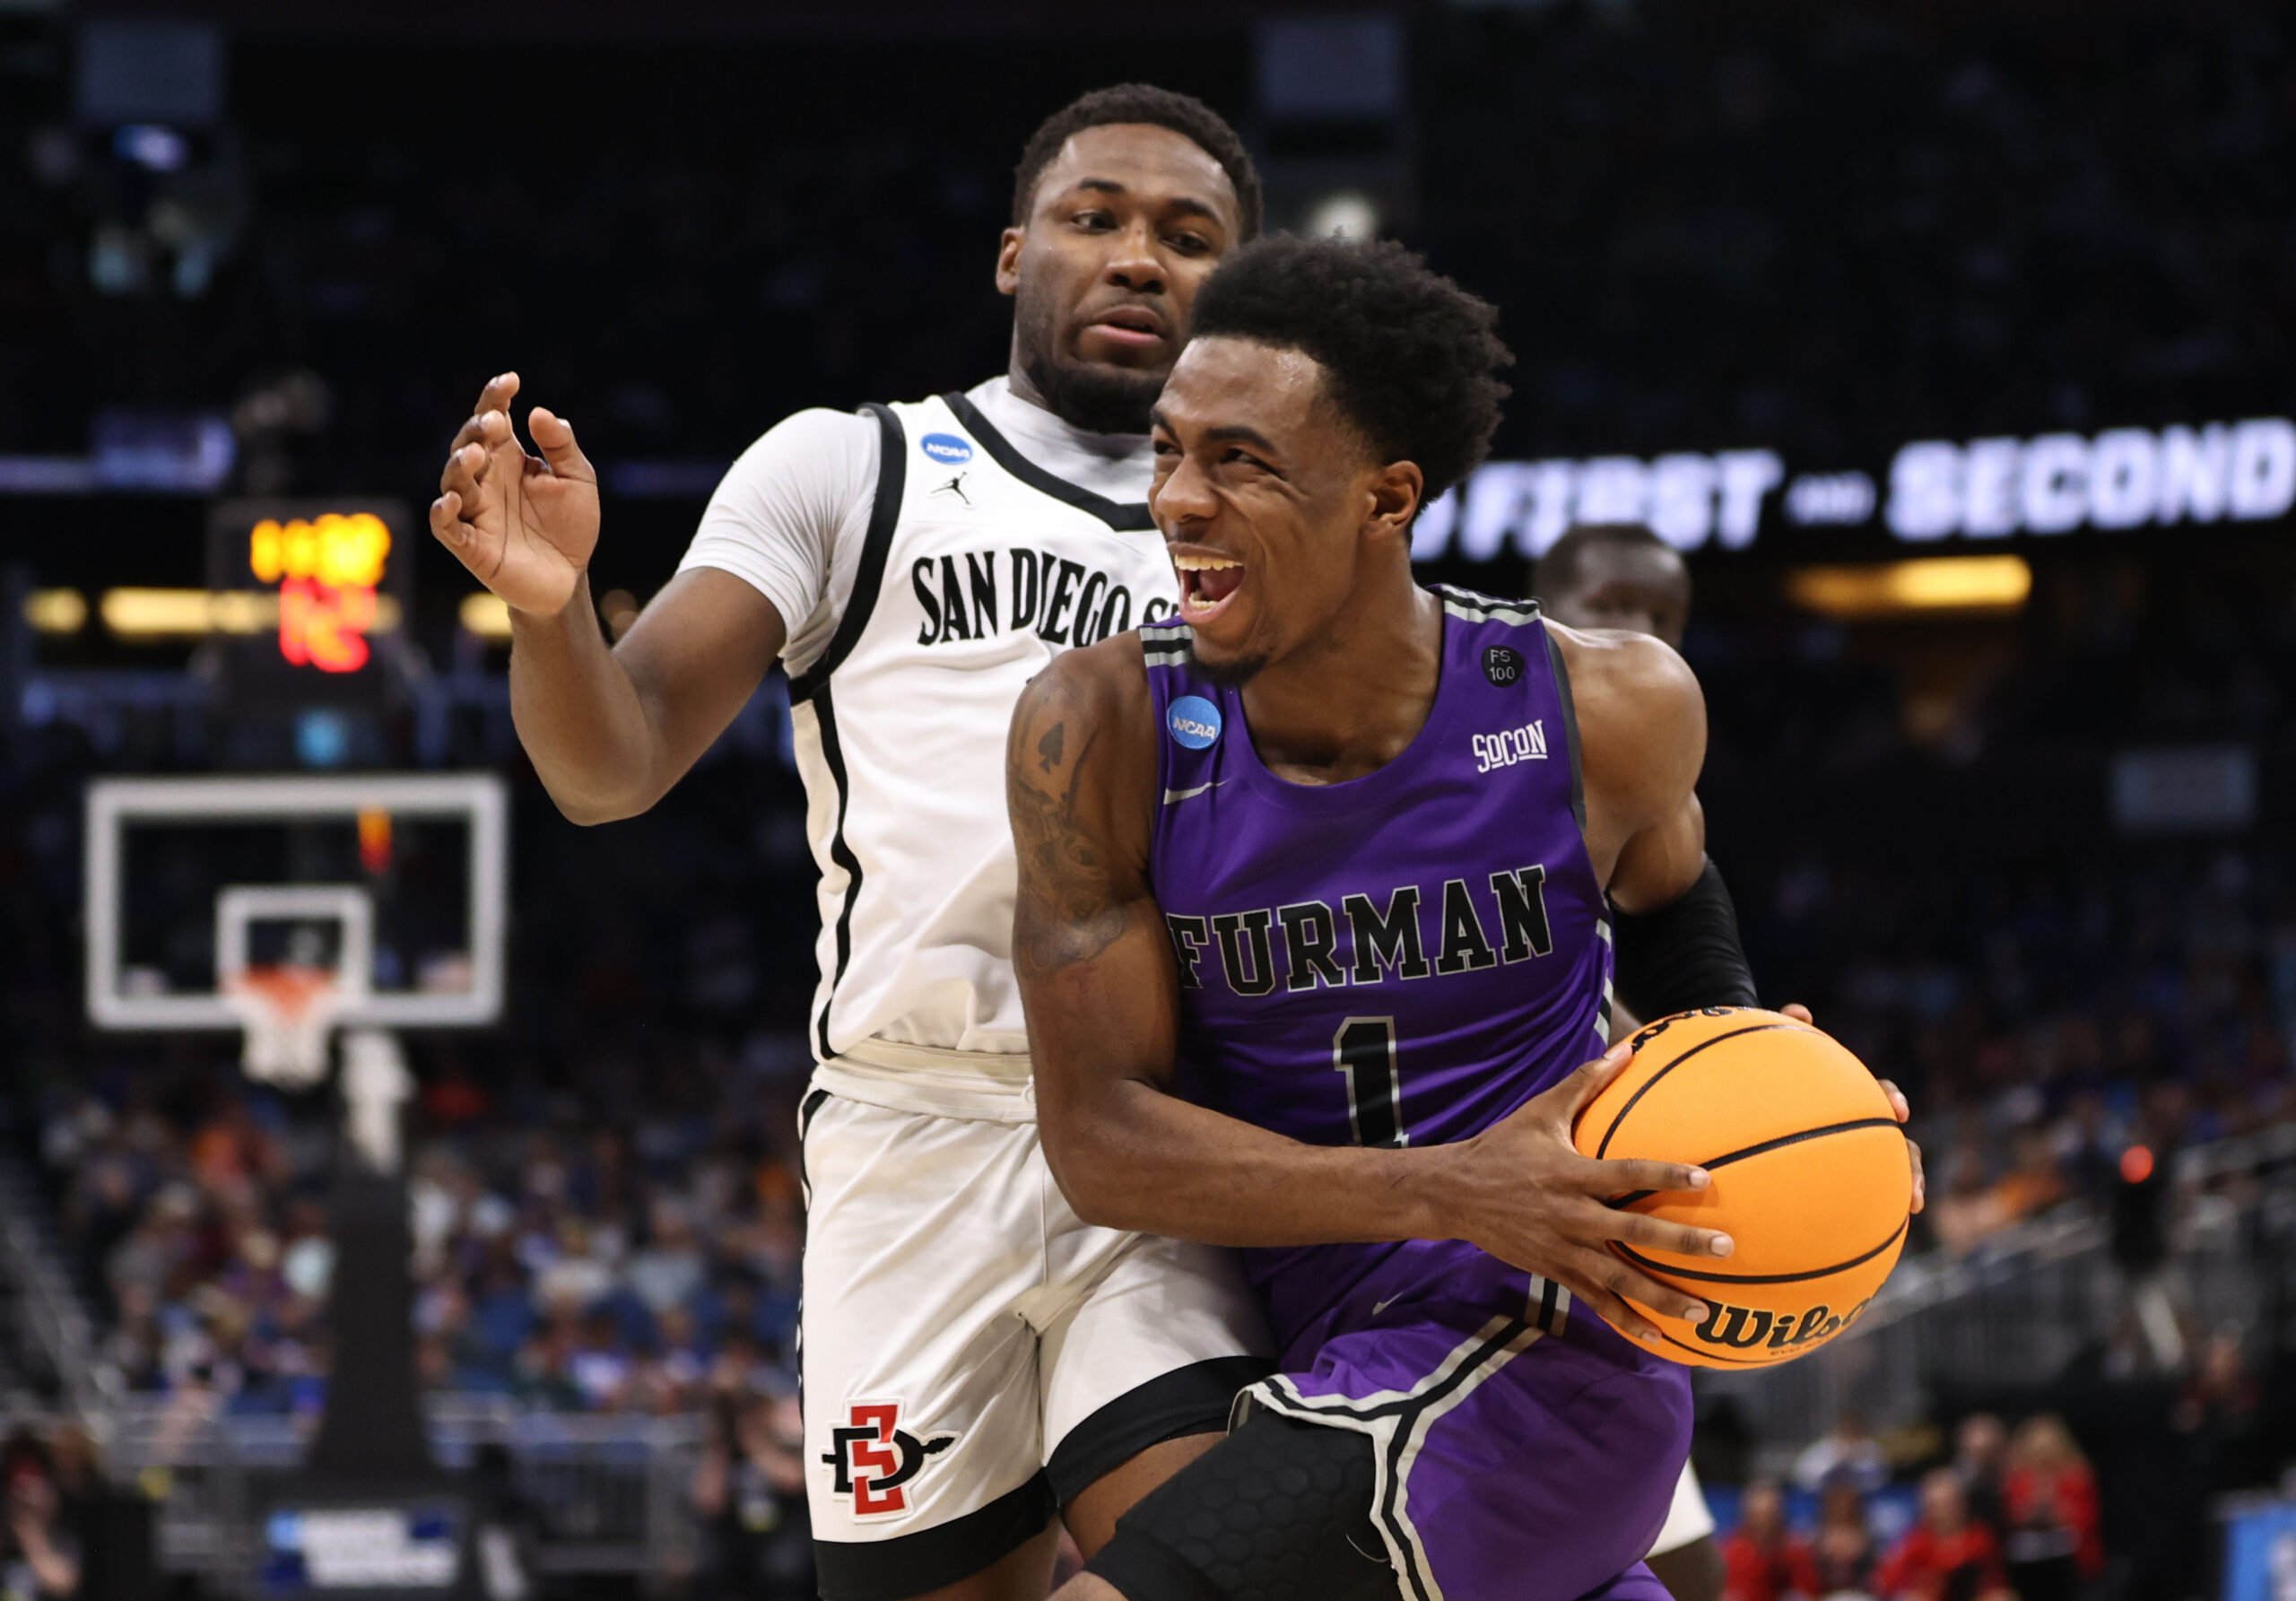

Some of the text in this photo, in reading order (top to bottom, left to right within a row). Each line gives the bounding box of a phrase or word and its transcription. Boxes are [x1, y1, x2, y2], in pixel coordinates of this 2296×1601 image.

[926, 442, 970, 458] NCAA
[1886, 415, 2296, 541] SECOND
[911, 547, 1132, 648] SAN DIEGO
[1489, 666, 1515, 681] 100
[1490, 648, 1511, 664] FS
[1173, 716, 1217, 740] NCAA
[1472, 719, 1548, 773] SOCON
[1166, 864, 1553, 996] FURMAN
[1333, 1015, 1409, 1149] 1
